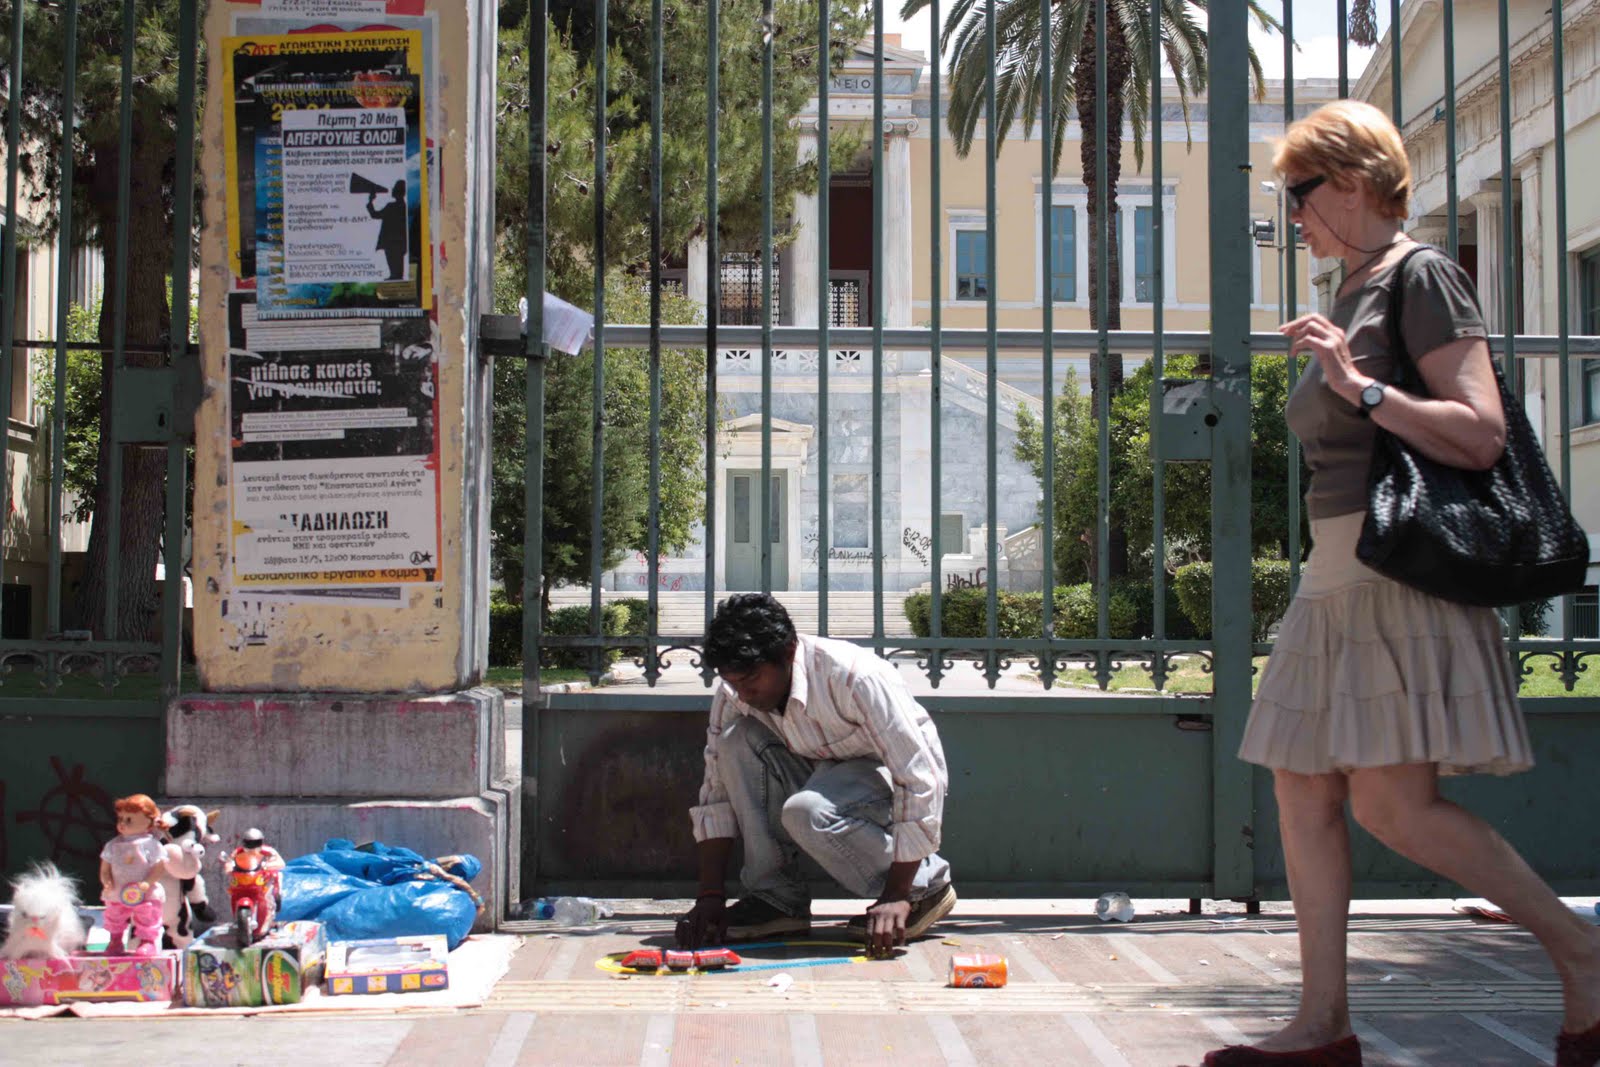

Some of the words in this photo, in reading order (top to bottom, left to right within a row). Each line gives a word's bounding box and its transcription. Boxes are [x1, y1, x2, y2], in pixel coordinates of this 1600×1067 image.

[280, 40, 342, 49] ΑΓΩΝΙΣΤΙΚΗ
[318, 114, 356, 127] Πέμπτη
[360, 113, 373, 125] 20
[376, 113, 398, 126] Μάη
[286, 131, 360, 146] ΑΠΕΡΓΟΥΜΕ
[363, 130, 397, 144] ΟΛΟΙ!
[251, 362, 310, 381] μίλησε
[316, 359, 372, 379] κανείς
